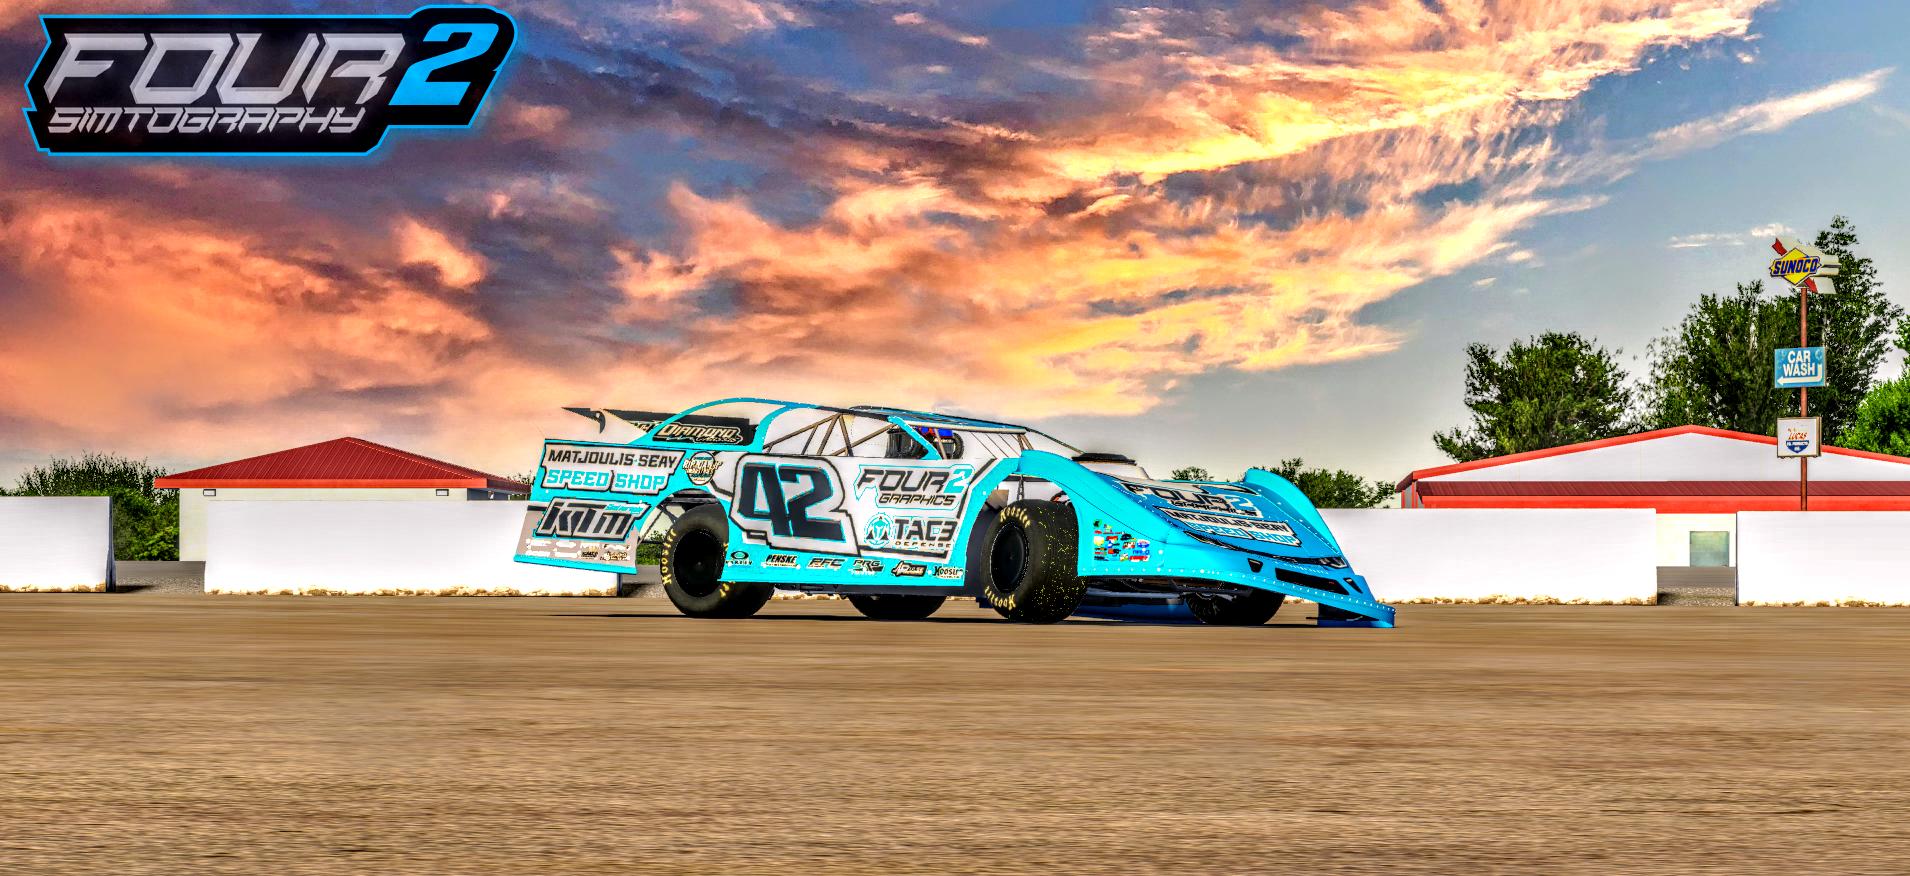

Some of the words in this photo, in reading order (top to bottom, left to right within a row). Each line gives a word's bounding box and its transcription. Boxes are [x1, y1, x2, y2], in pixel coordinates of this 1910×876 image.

[1773, 257, 1820, 275] SUNOCO
[1787, 350, 1811, 364] CAR
[1783, 362, 1816, 377] WASH
[547, 469, 610, 487] SPEED
[615, 473, 666, 491] SHOP
[737, 462, 847, 542] 42
[878, 493, 955, 506] GRAPHICS
[894, 518, 959, 541] TAC3
[1252, 530, 1296, 544] SHOP
